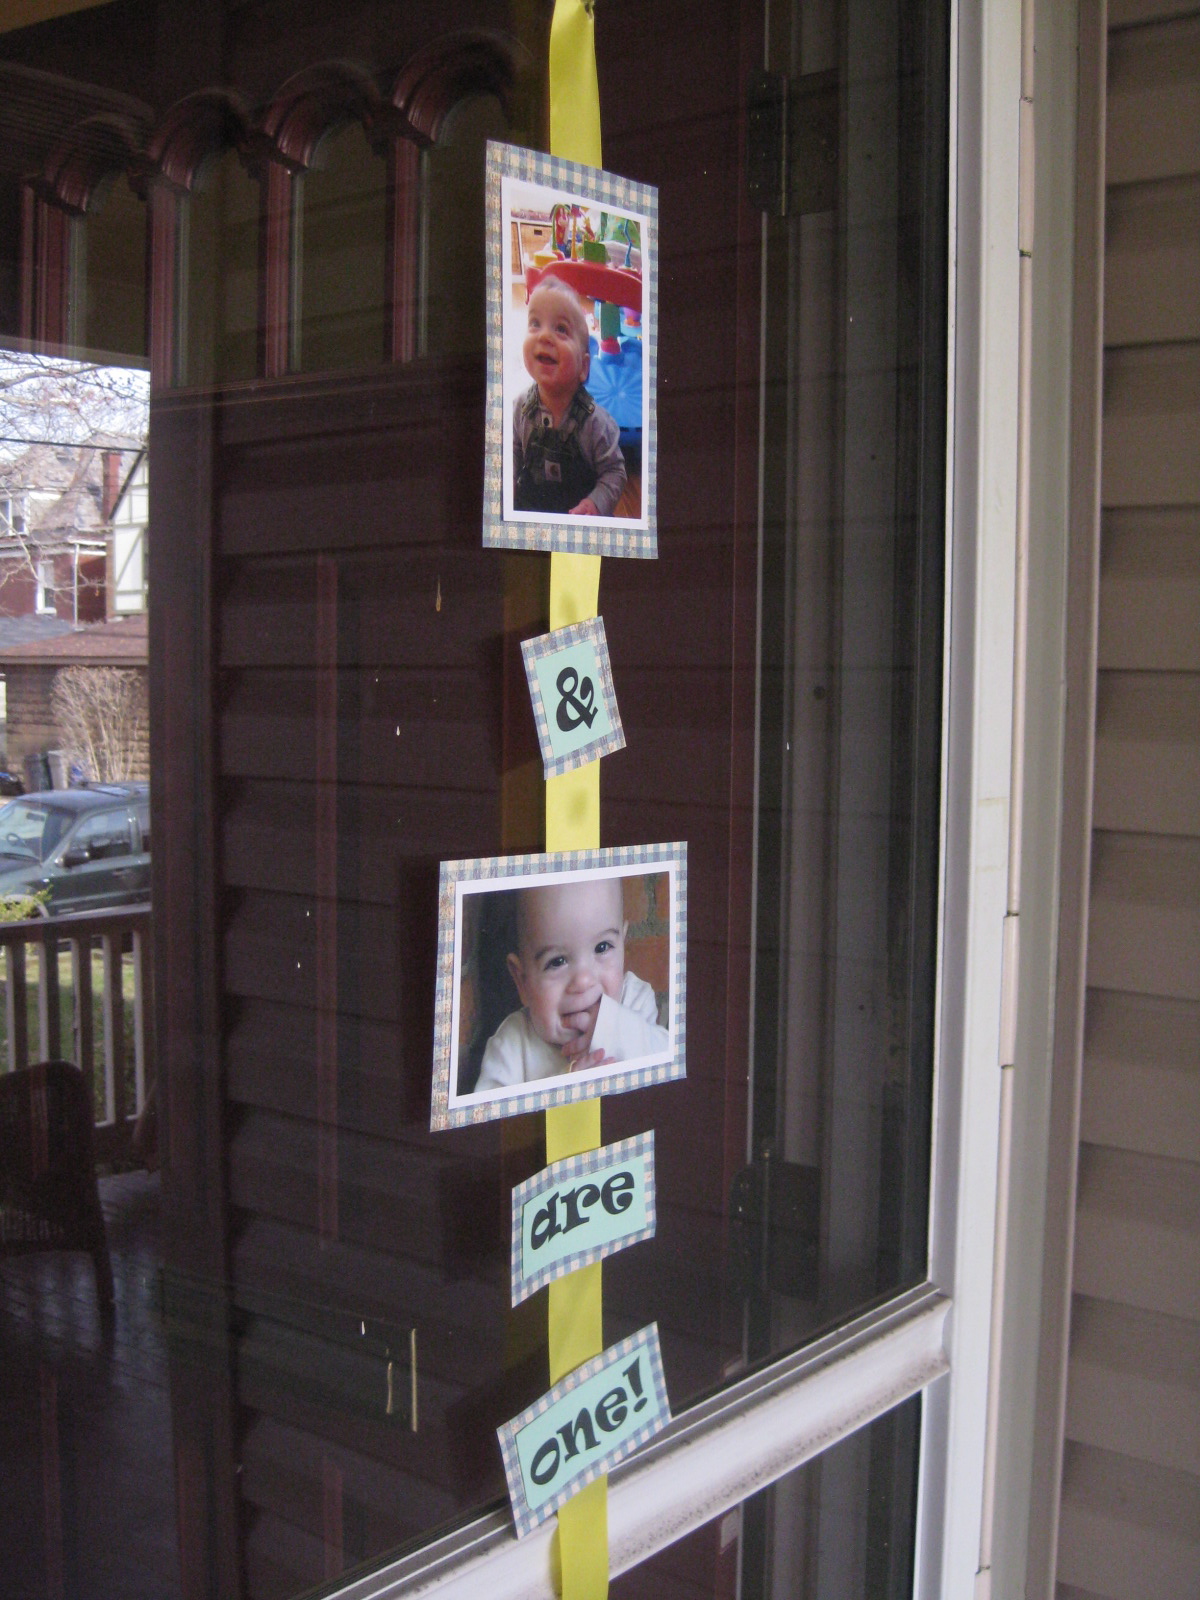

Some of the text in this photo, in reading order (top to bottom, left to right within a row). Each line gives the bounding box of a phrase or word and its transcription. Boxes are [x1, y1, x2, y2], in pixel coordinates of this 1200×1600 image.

[556, 666, 599, 732] &
[530, 1171, 635, 1251] are
[530, 1356, 648, 1486] one!
